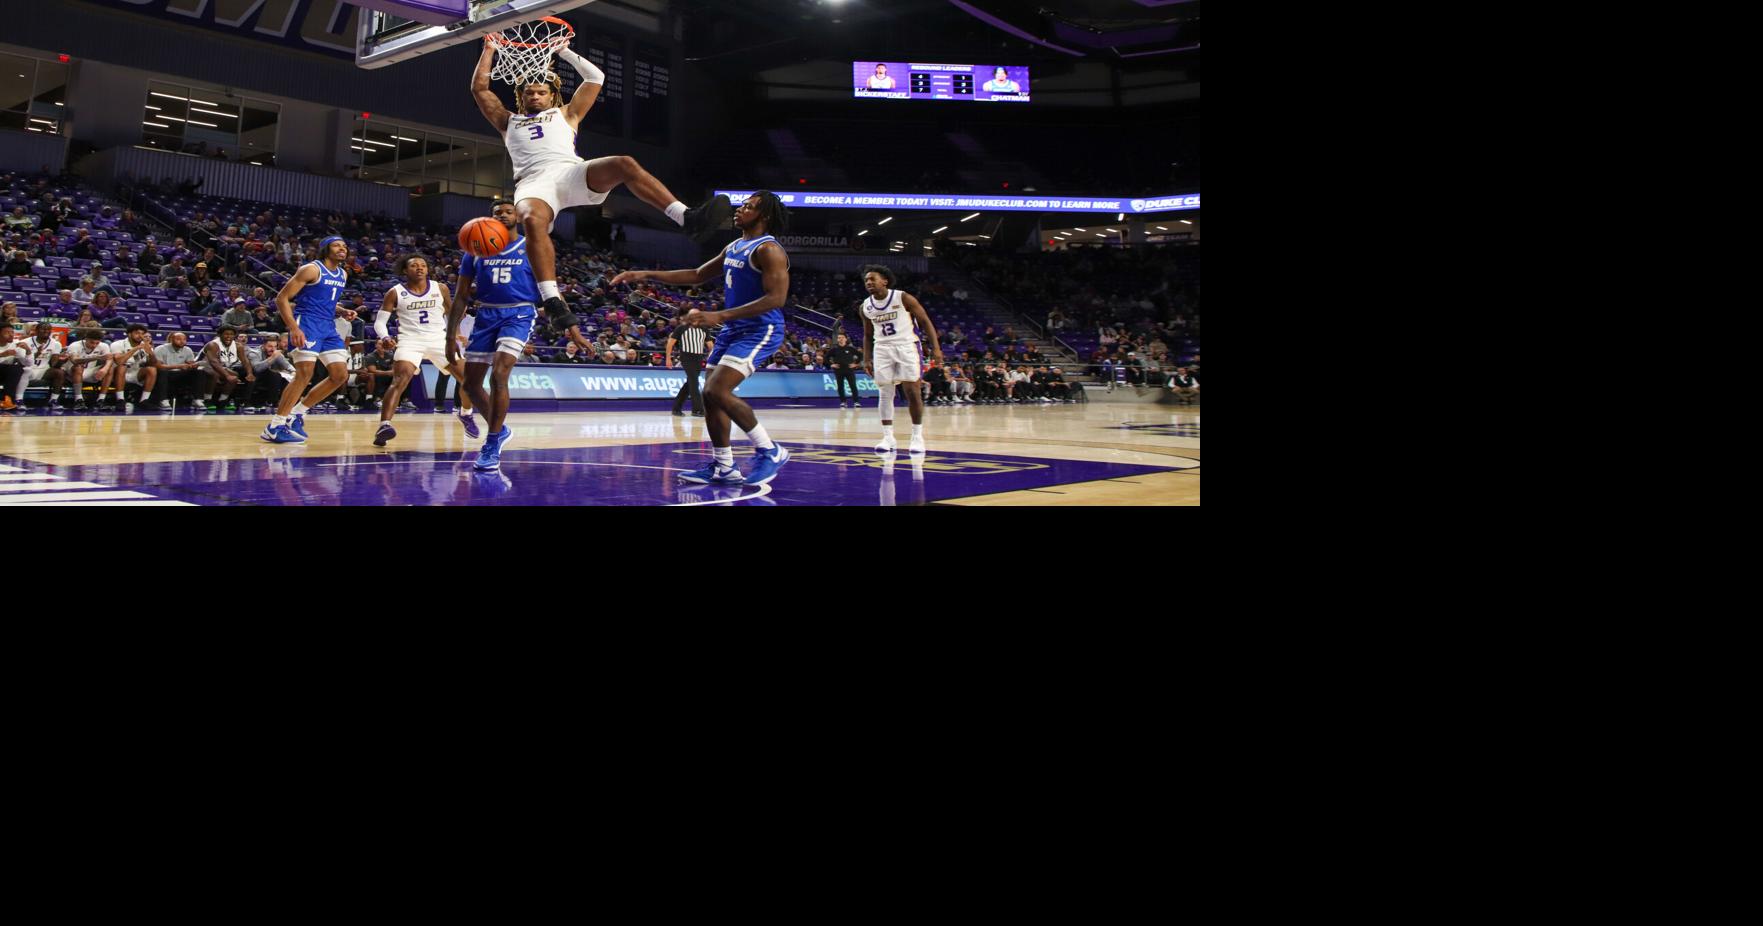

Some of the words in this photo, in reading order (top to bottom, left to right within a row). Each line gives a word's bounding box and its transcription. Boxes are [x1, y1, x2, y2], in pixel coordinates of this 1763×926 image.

[528, 125, 544, 140] 3
[805, 196, 845, 205] BECOME
[846, 197, 853, 205] A
[854, 197, 895, 206] MEMBER
[897, 198, 929, 206] TODAY!
[931, 199, 956, 207] VISIT:
[957, 199, 1047, 209] JMUDUKECLUB.COM
[1048, 201, 1060, 209] TO
[1062, 201, 1091, 210] LEARN
[1093, 201, 1121, 210] MORE
[1145, 197, 1184, 209] DUKE
[491, 267, 512, 284] 15
[725, 269, 733, 288] 4
[331, 287, 337, 301] 1
[407, 300, 436, 310] JMU
[419, 311, 429, 324] 2
[881, 323, 897, 336] 13
